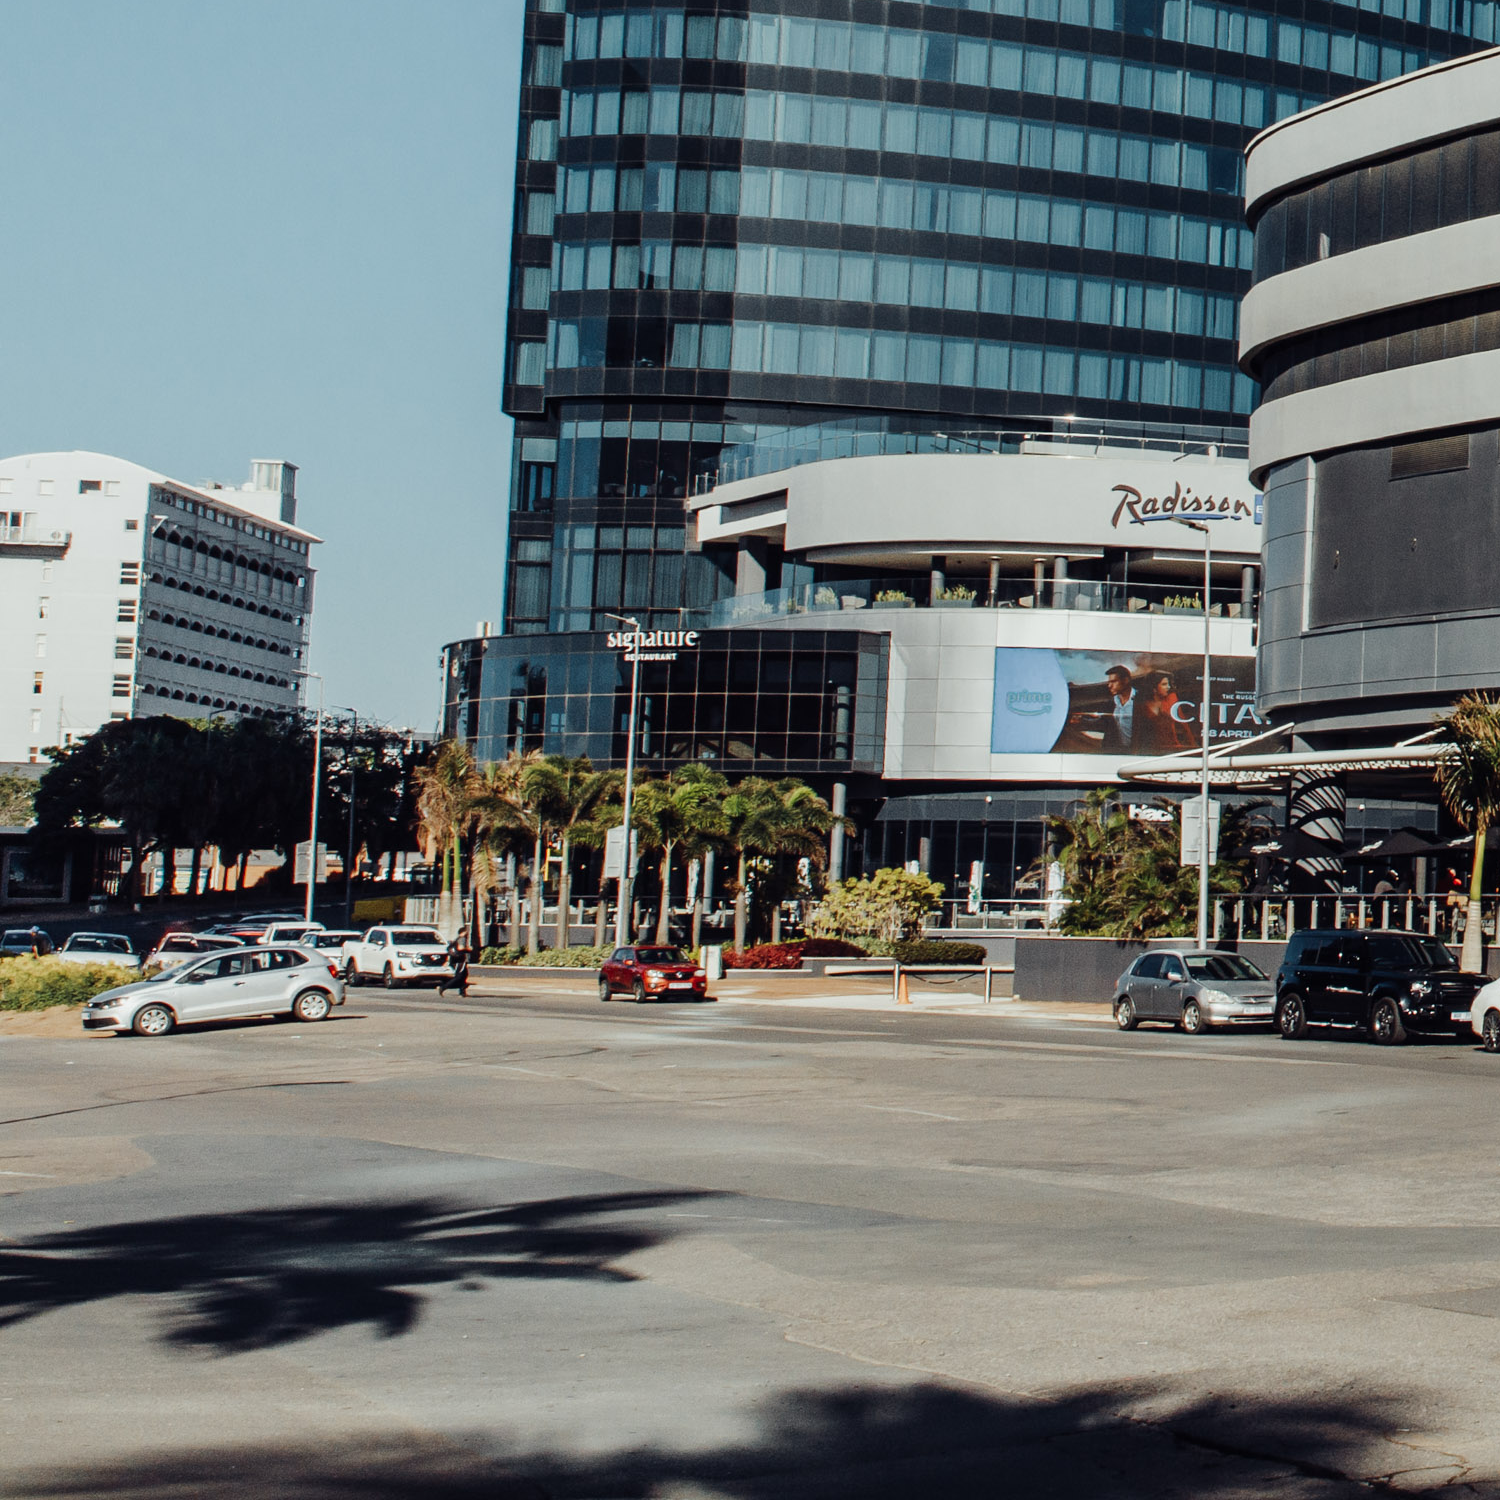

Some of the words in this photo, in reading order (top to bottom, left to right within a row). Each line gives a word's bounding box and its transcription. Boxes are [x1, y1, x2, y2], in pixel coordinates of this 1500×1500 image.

[1111, 480, 1252, 529] Radisson
[606, 629, 698, 652] signature
[1006, 688, 1052, 706] prime
[1170, 700, 1272, 725] CITA
